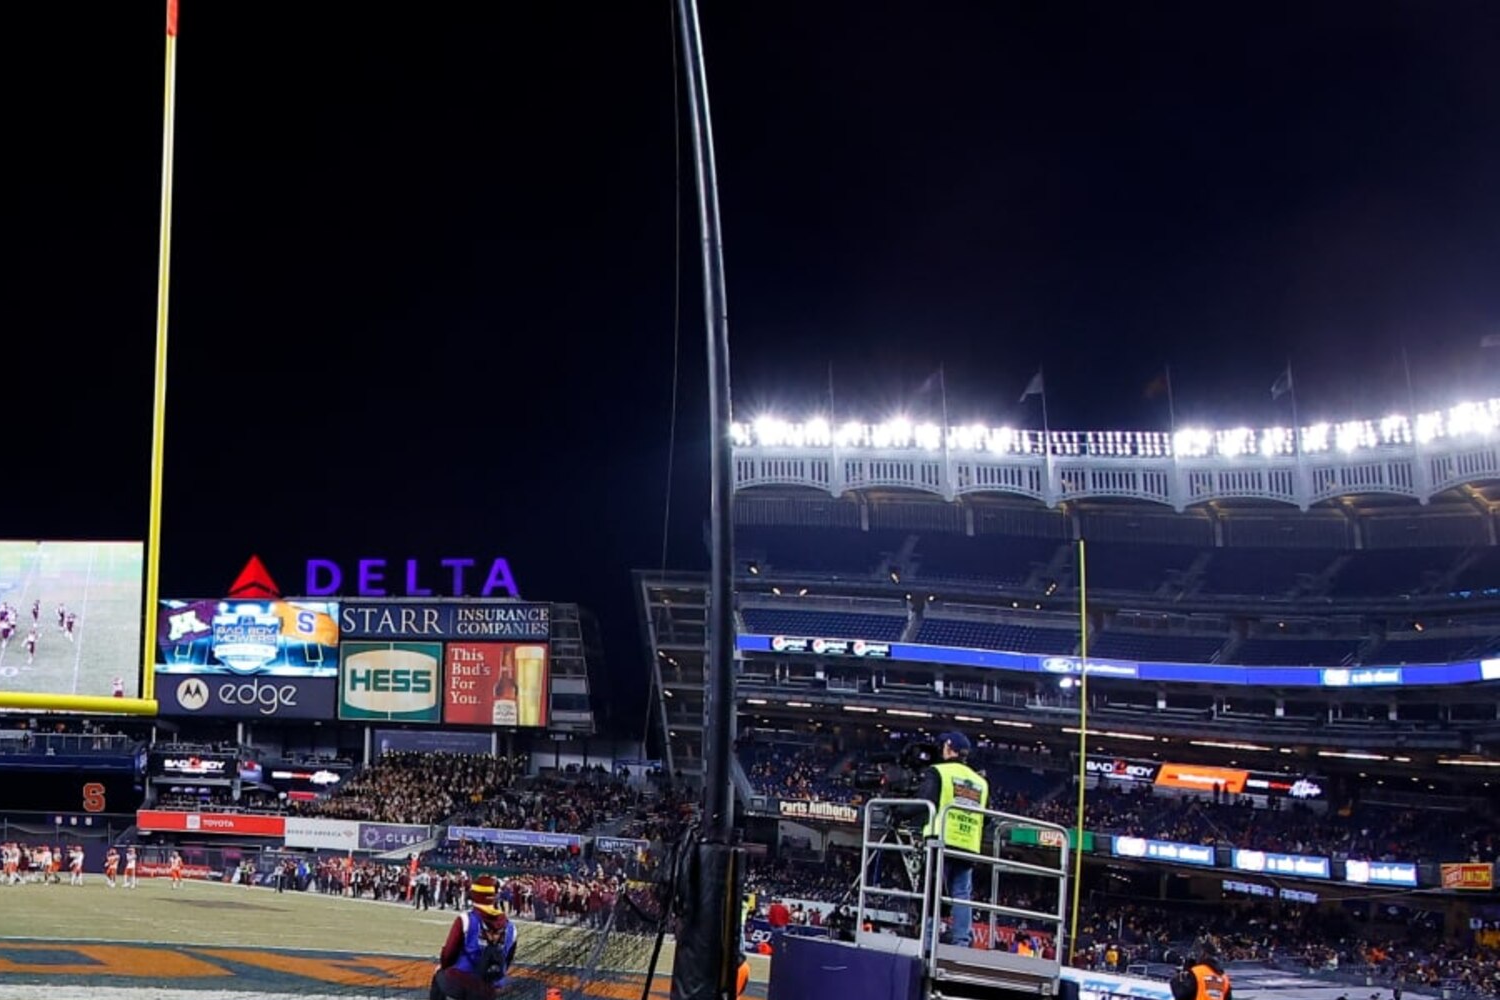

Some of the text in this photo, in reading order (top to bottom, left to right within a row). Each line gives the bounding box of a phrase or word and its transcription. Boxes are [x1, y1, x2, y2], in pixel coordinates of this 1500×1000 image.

[306, 558, 519, 597] DELTA
[342, 607, 445, 636] STARR
[457, 608, 550, 621] INSURANCE
[456, 622, 549, 635] COMPANIES
[451, 647, 484, 661] This
[451, 662, 491, 676] Bud's
[349, 669, 432, 693] HESS
[451, 676, 476, 689] For
[219, 678, 297, 715] edge
[451, 690, 481, 705] You.
[164, 759, 190, 768] BAD
[1086, 761, 1154, 776] BAD BOY
[780, 801, 857, 820] Parts Authority
[202, 818, 235, 828] TOYOTA
